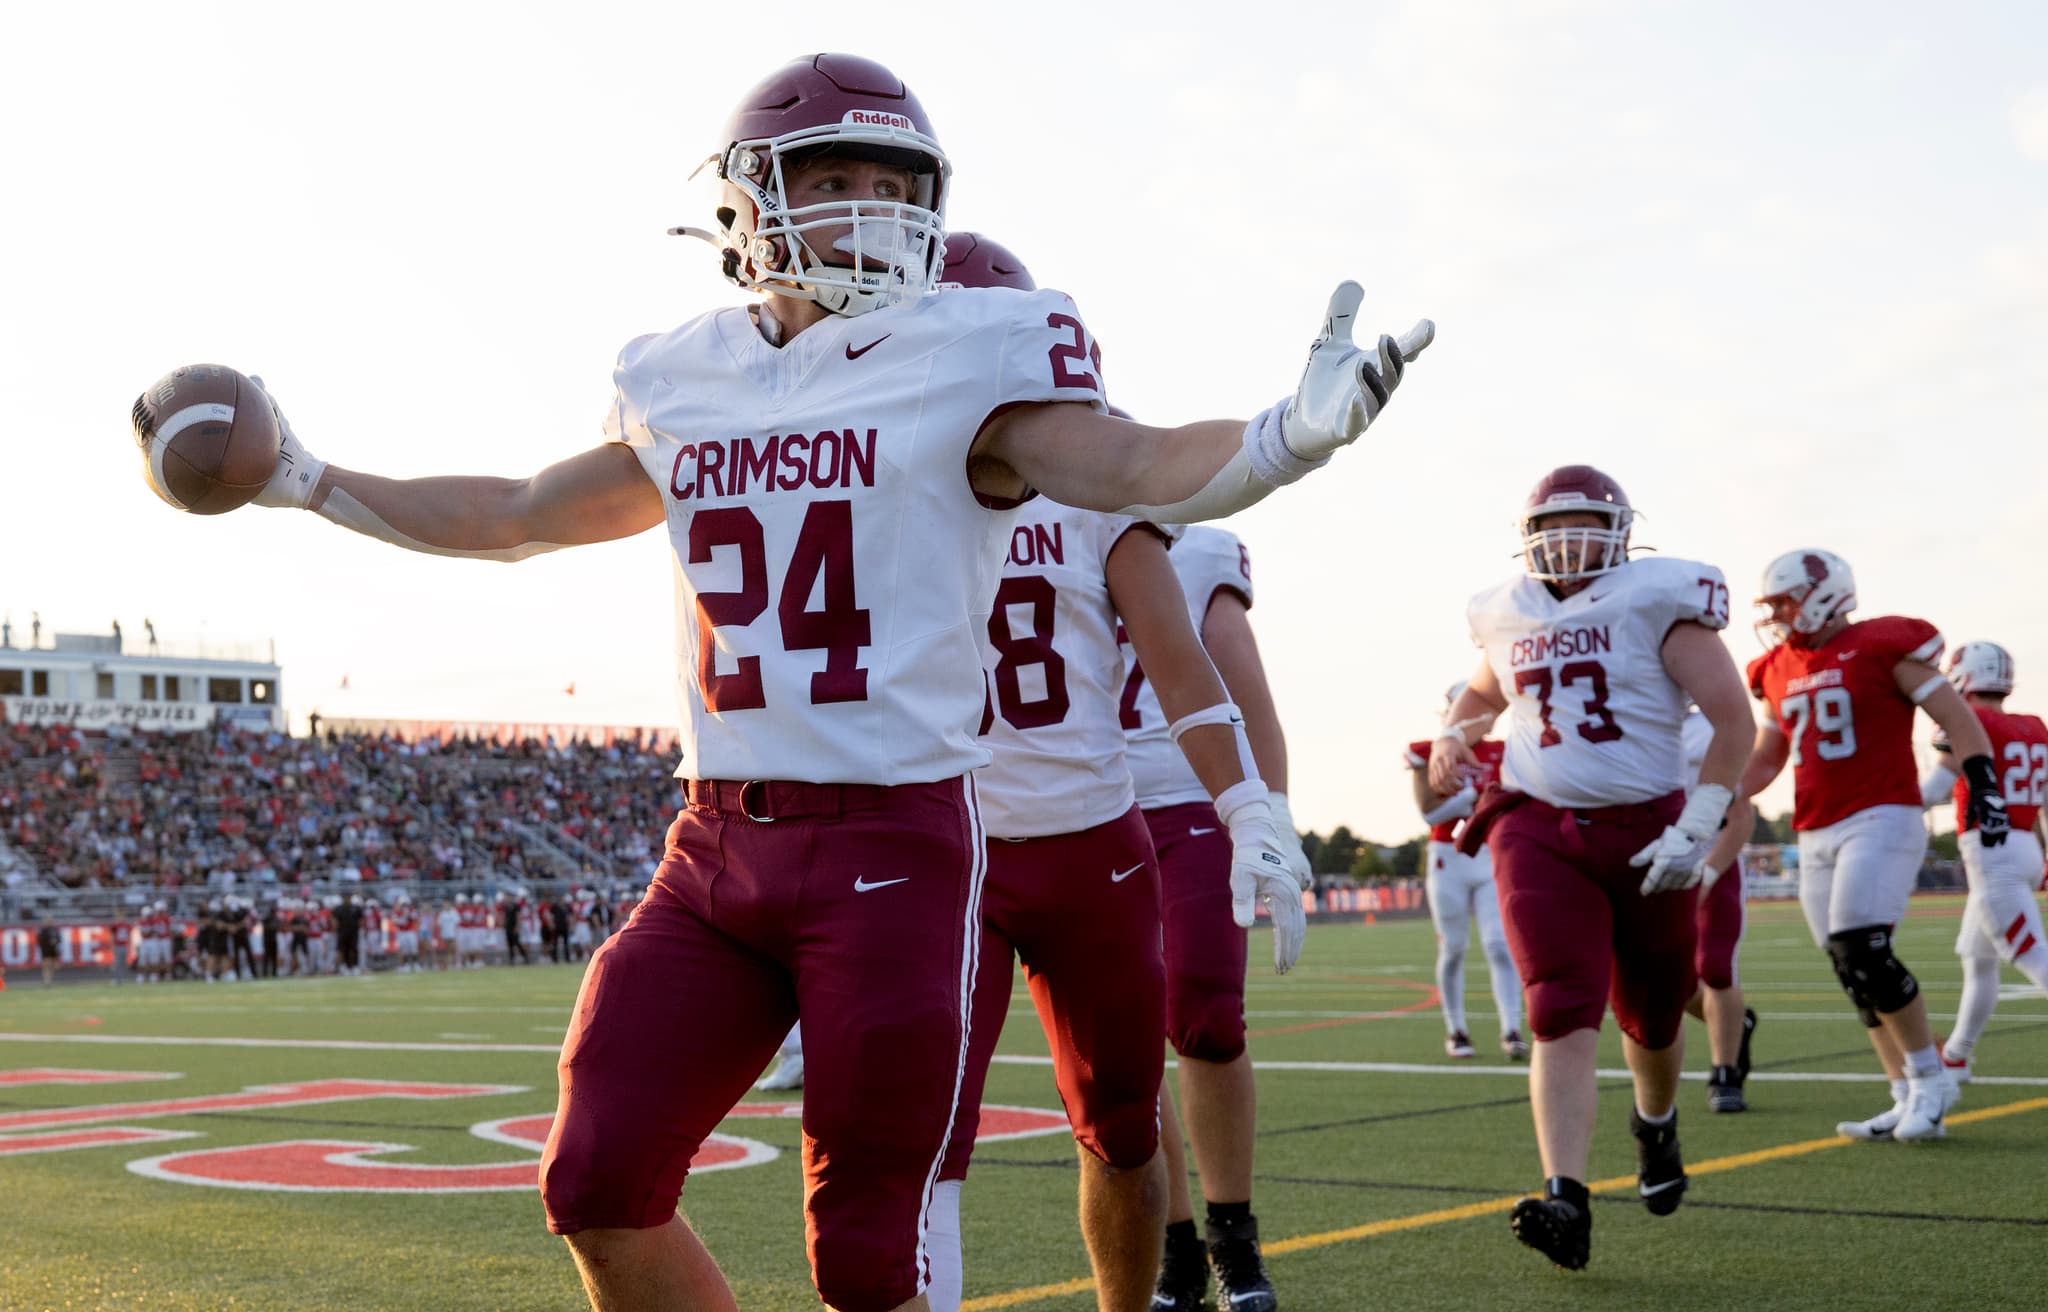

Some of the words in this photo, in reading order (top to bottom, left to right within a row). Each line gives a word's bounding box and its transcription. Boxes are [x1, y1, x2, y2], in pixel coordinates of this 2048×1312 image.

[852, 111, 910, 130] Riddell
[851, 276, 880, 286] Rddell
[670, 428, 878, 500] CRIMSON
[1003, 522, 1065, 568] ON
[688, 500, 872, 714] 24
[1698, 577, 1729, 620] 73
[977, 574, 1071, 737] 8
[1510, 625, 1612, 667] CRIMSON
[1514, 660, 1624, 749] 73
[1780, 687, 1857, 766] 79
[2003, 741, 2048, 806] 22
